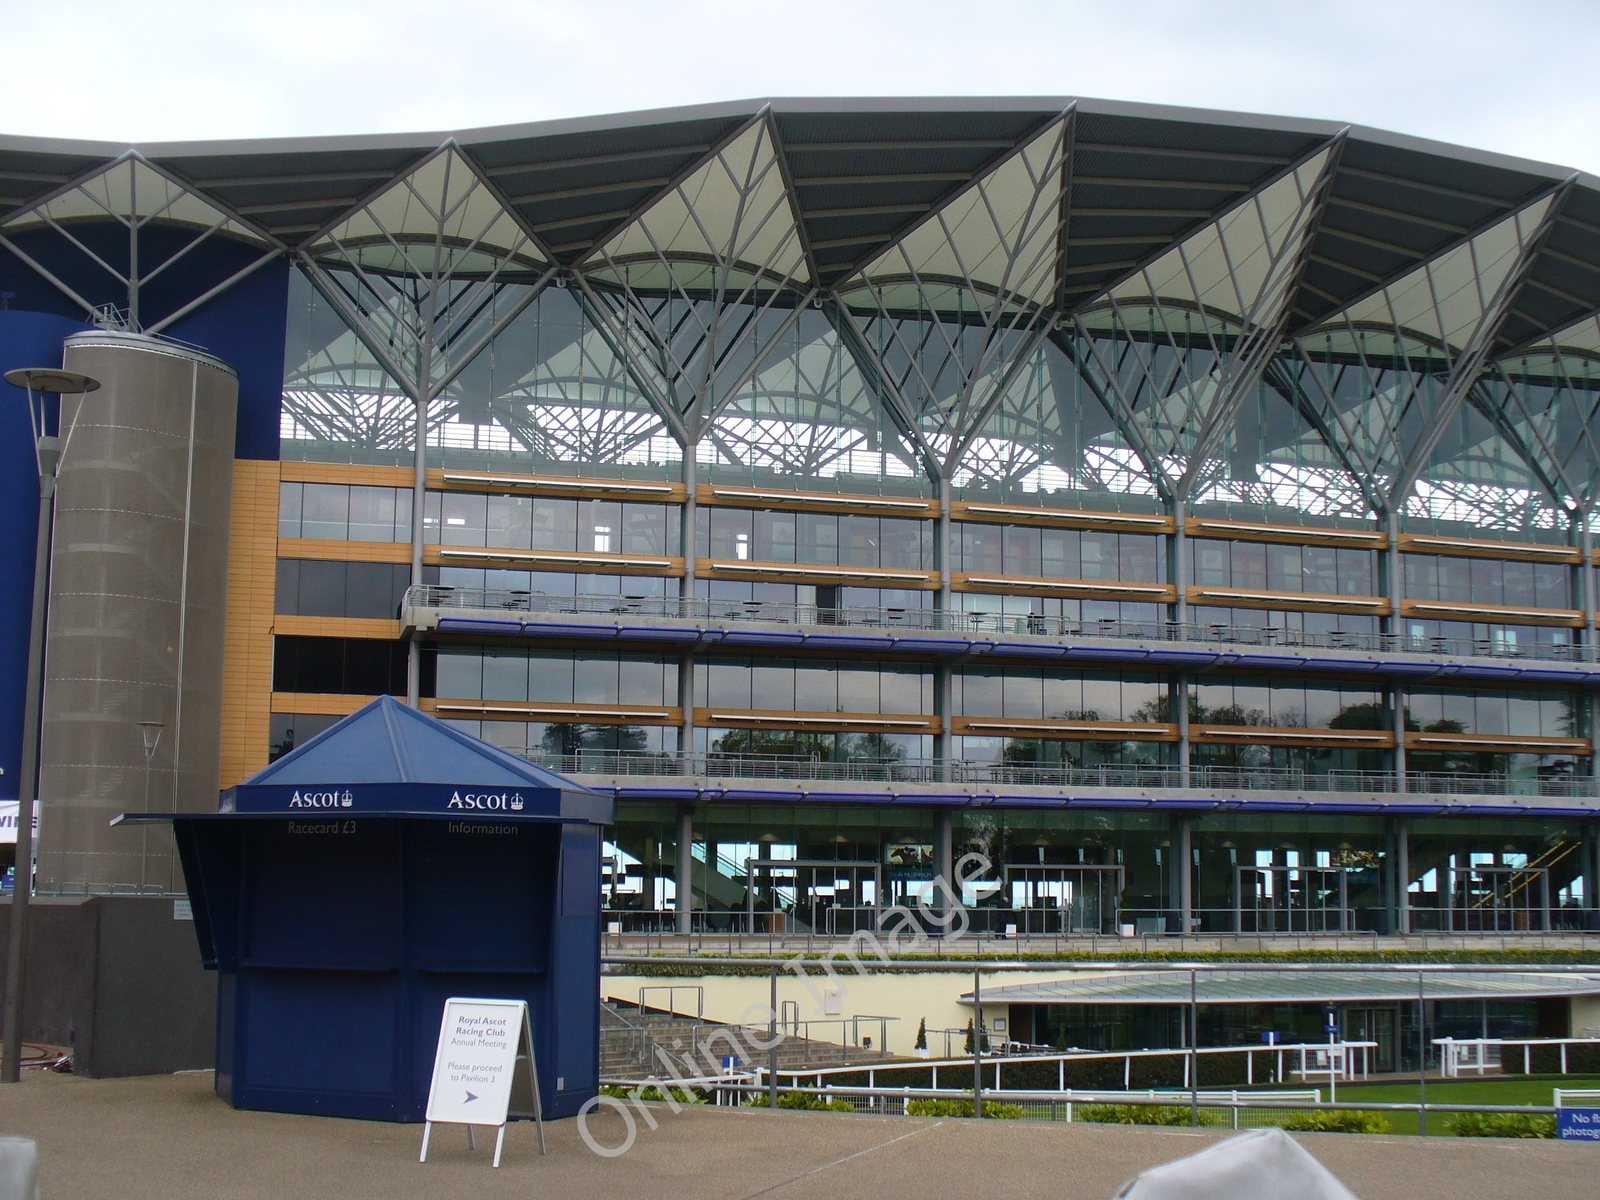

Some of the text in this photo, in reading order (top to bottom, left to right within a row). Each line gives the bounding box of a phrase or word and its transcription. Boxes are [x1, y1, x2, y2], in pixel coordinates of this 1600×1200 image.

[288, 790, 340, 808] Ascot
[446, 791, 508, 810] Ascot
[288, 821, 357, 834] Racecard £3
[449, 821, 518, 835] Information
[458, 1016, 507, 1026] Royal Ascot
[456, 1027, 506, 1037] Racing Club
[451, 1037, 507, 1050] Annual Meeting
[447, 1062, 503, 1073] Please proceed
[461, 1074, 489, 1083] Pavilion
[490, 1075, 496, 1083] 3
[1571, 1113, 1590, 1124] No
